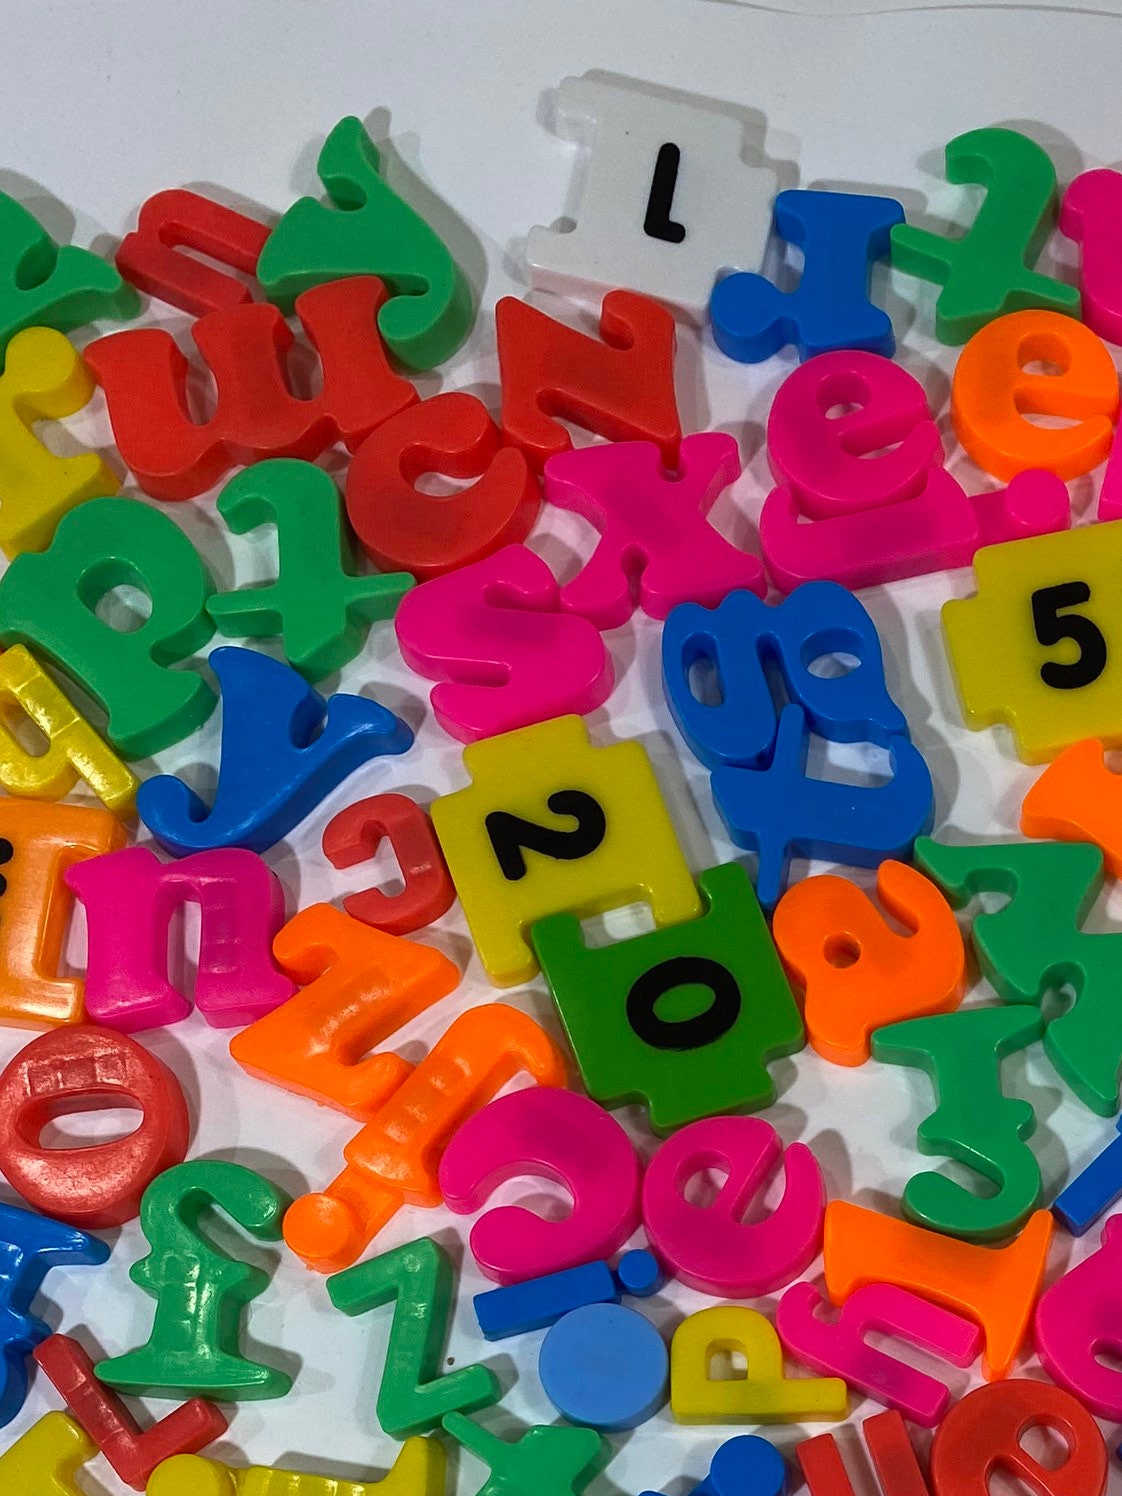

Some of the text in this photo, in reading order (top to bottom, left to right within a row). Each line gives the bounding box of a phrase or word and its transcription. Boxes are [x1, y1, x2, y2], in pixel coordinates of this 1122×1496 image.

[889, 127, 1082, 347] t
[768, 350, 945, 522] e
[950, 308, 1121, 485] e
[205, 457, 417, 682] t
[393, 544, 616, 745] s
[1030, 580, 1108, 690] 5
[137, 646, 415, 856] y
[484, 790, 607, 882] 2
[64, 845, 300, 1032] n
[97, 1158, 294, 1402] f
[642, 1114, 827, 1299] e
